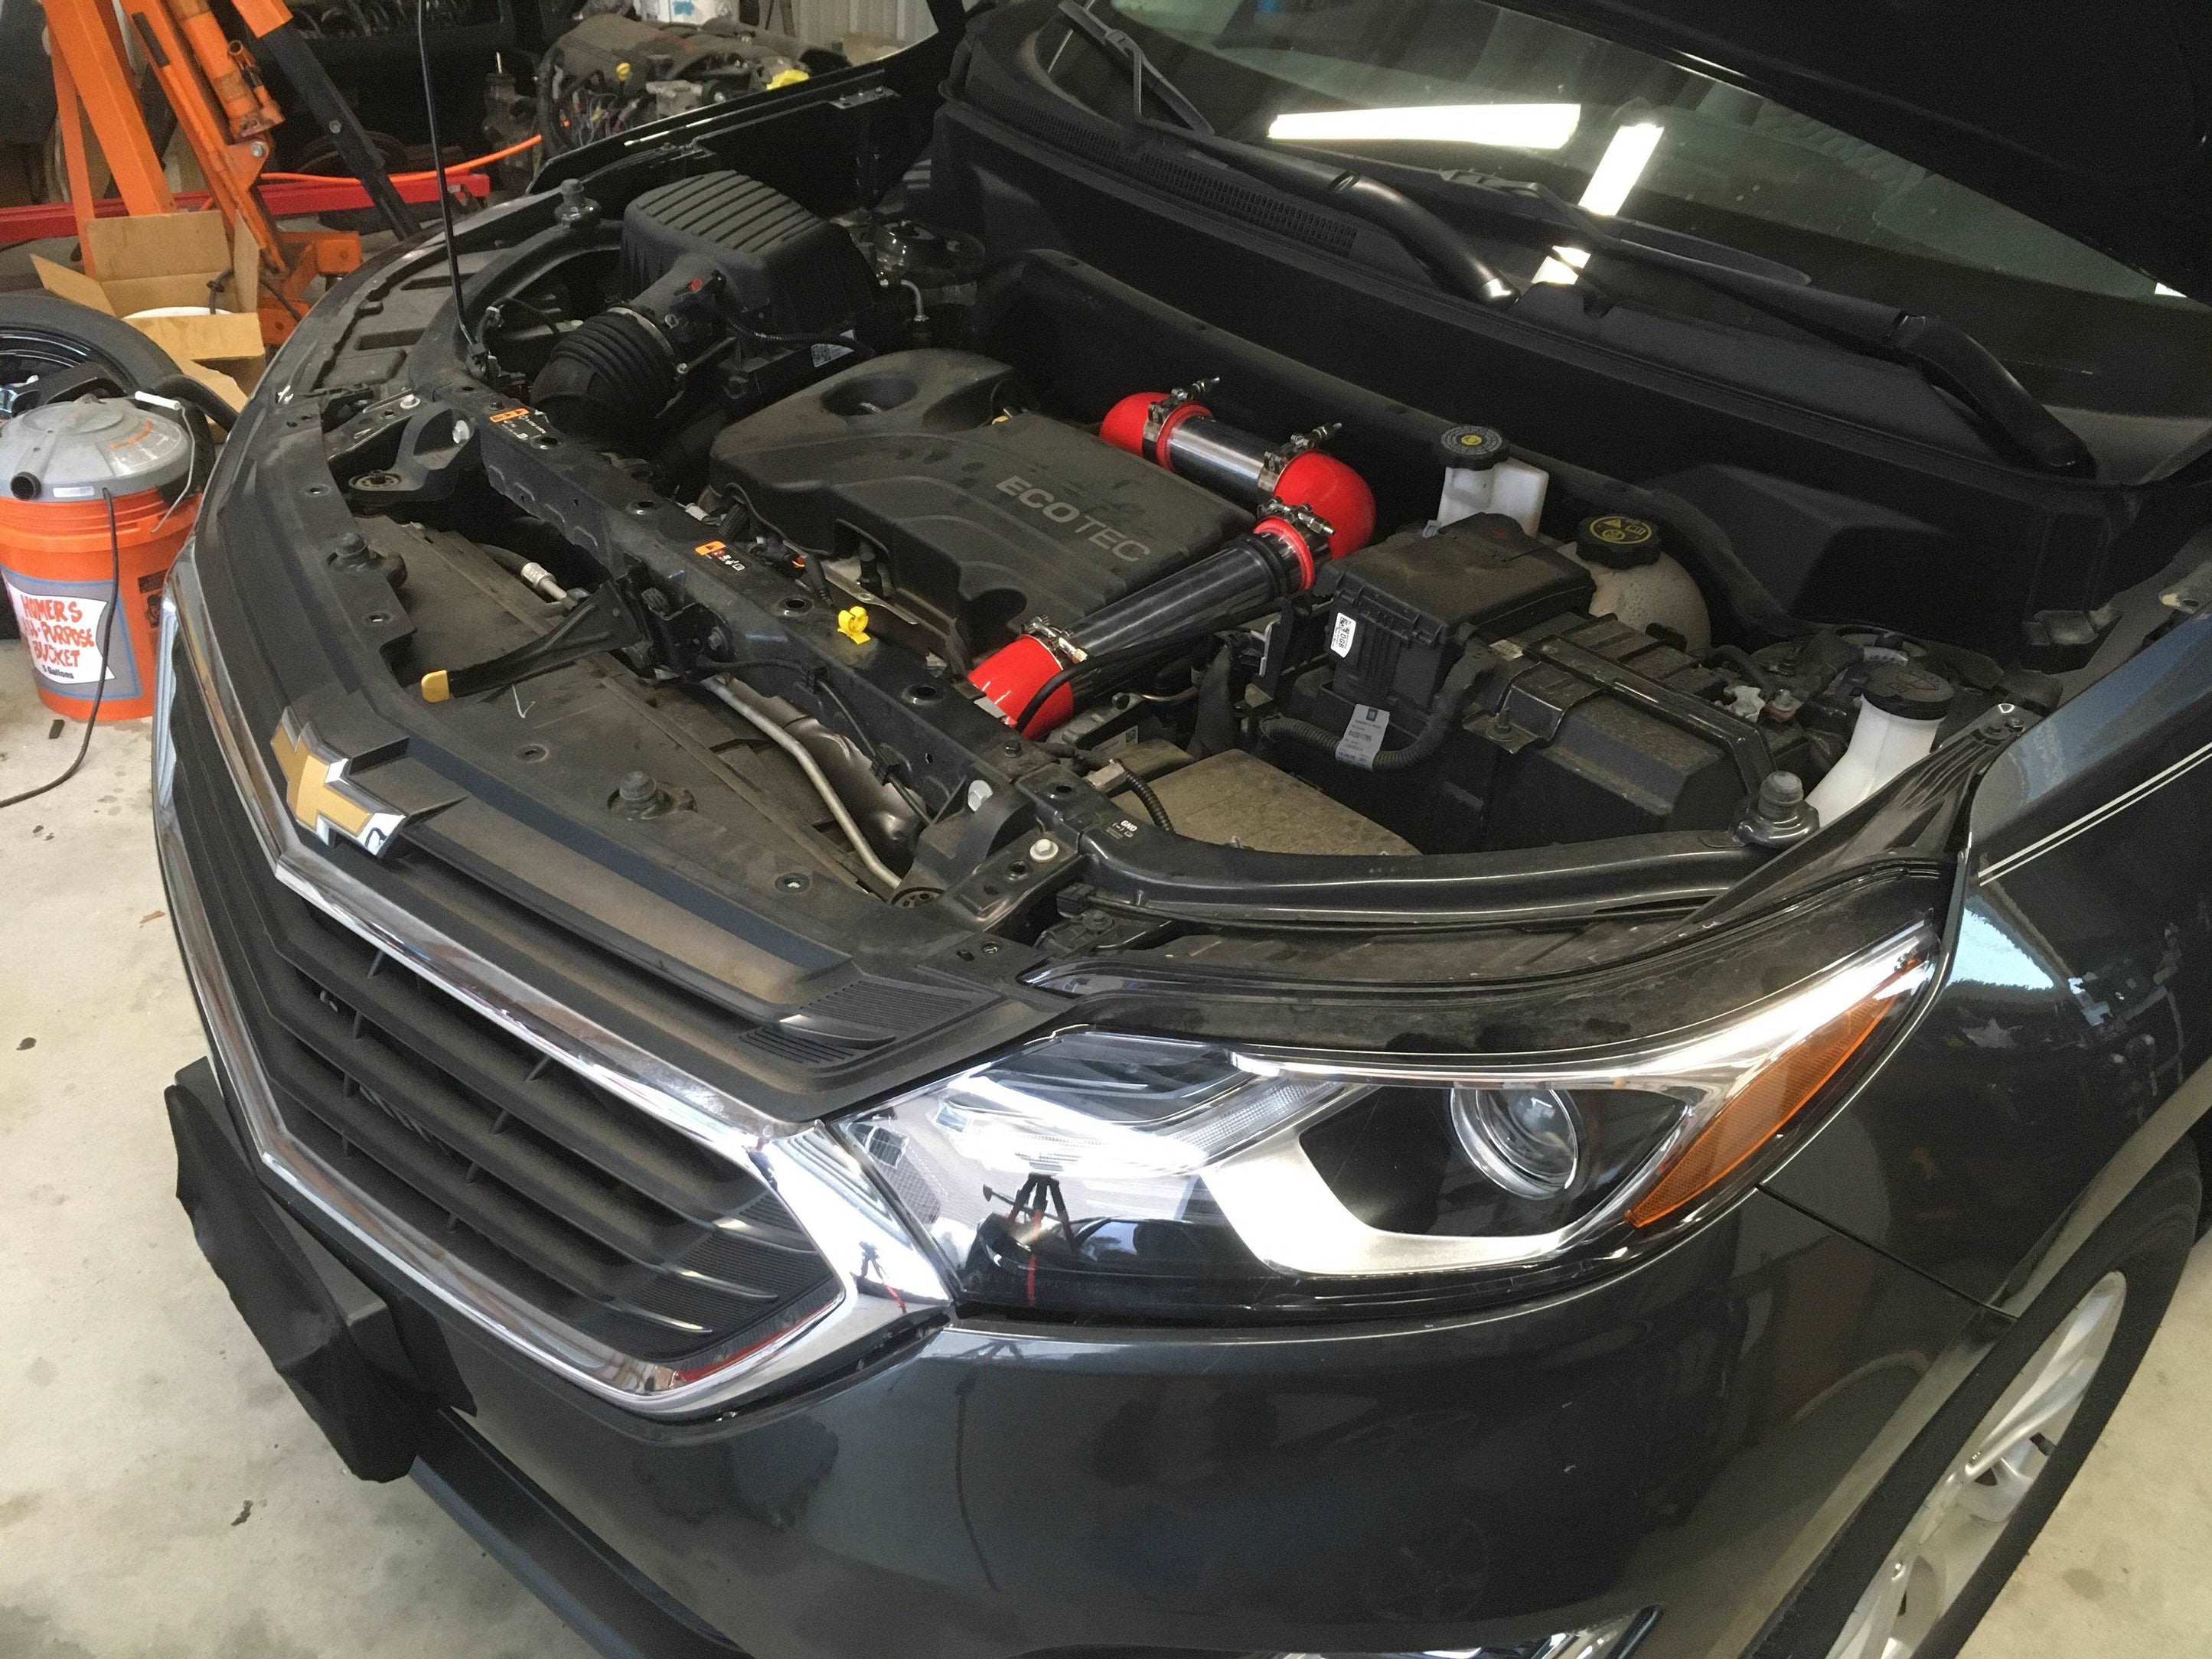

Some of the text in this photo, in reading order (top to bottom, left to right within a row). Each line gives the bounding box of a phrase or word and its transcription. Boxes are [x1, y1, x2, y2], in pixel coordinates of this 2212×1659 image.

[995, 475, 1150, 562] ECOTEC
[32, 640, 80, 667] BUCKET
[42, 664, 75, 680] 5 Gallons
[1120, 820, 1138, 832] GND
